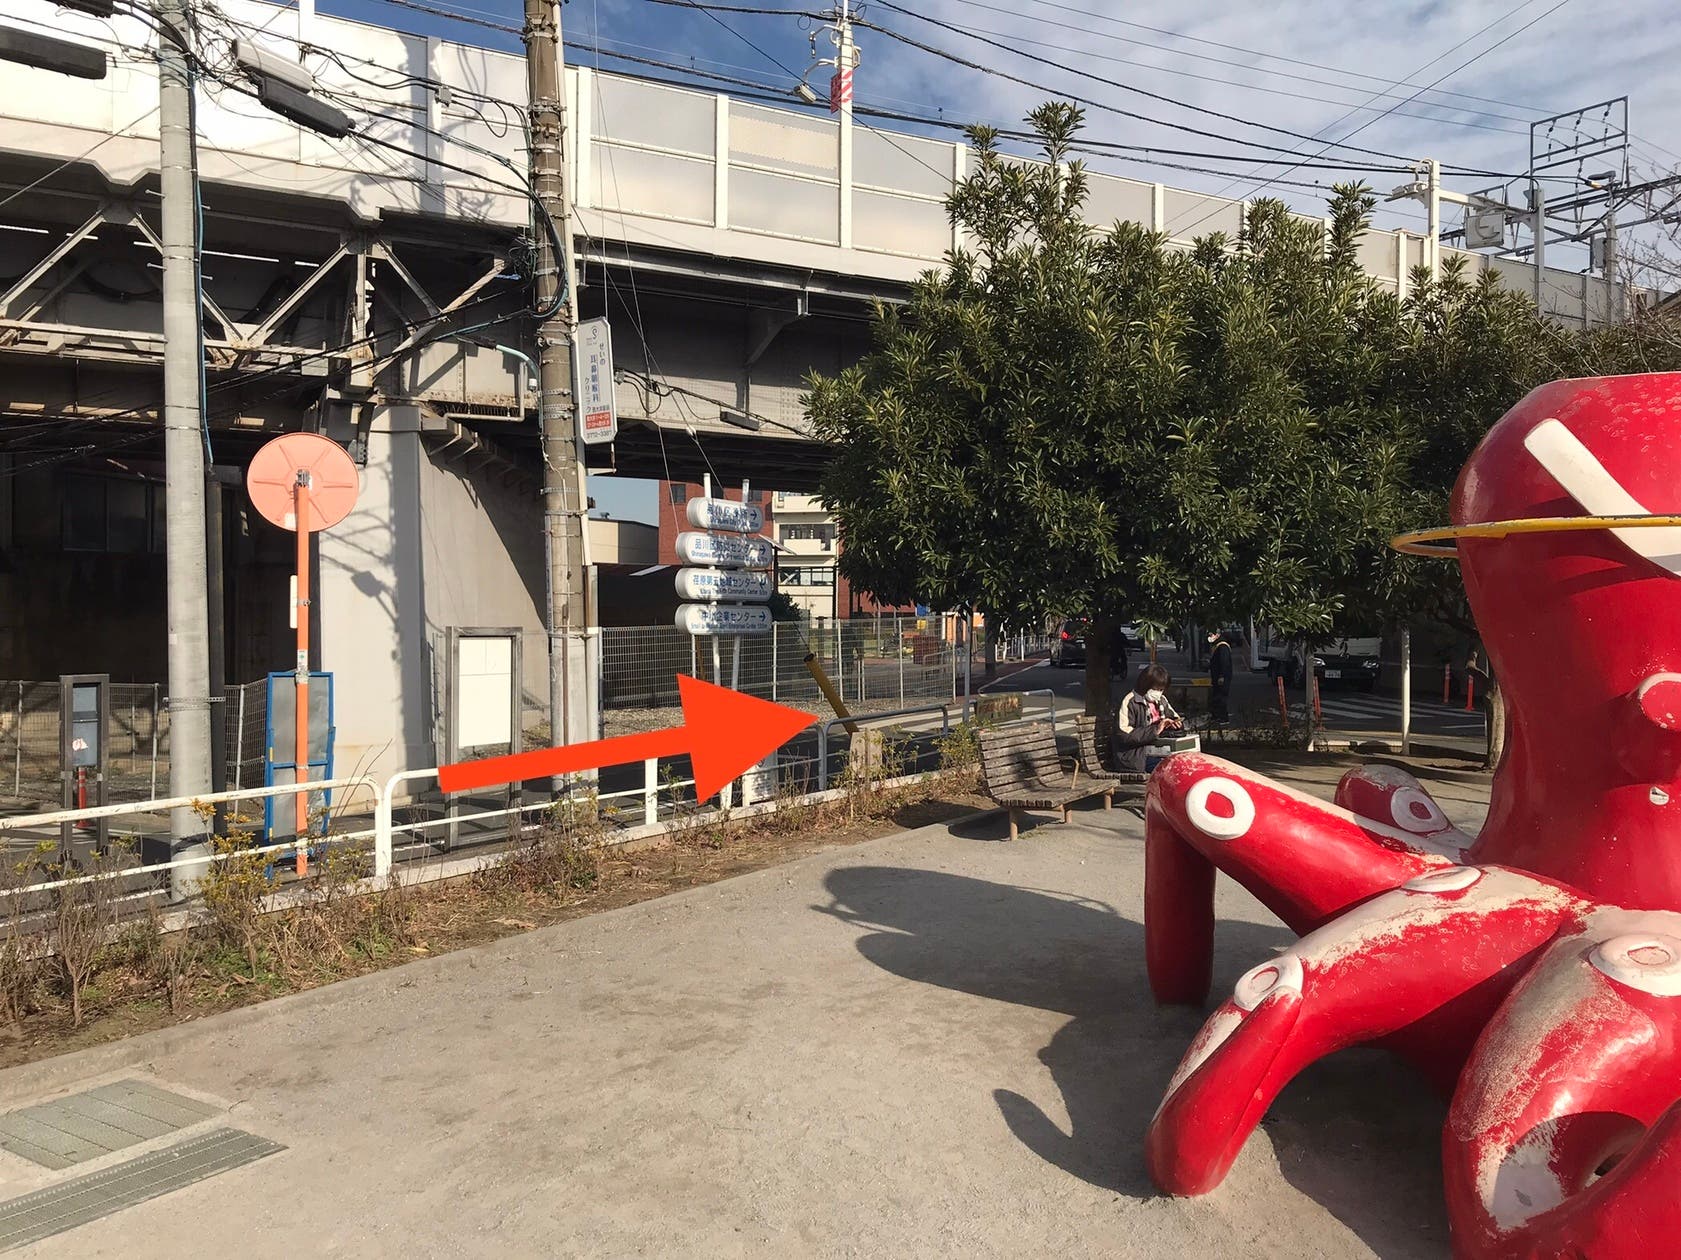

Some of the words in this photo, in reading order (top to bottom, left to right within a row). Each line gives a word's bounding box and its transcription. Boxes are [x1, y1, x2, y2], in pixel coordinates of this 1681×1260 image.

[695, 538, 754, 552] 品川区防災センタ
[701, 610, 757, 622] 中小企業センター
